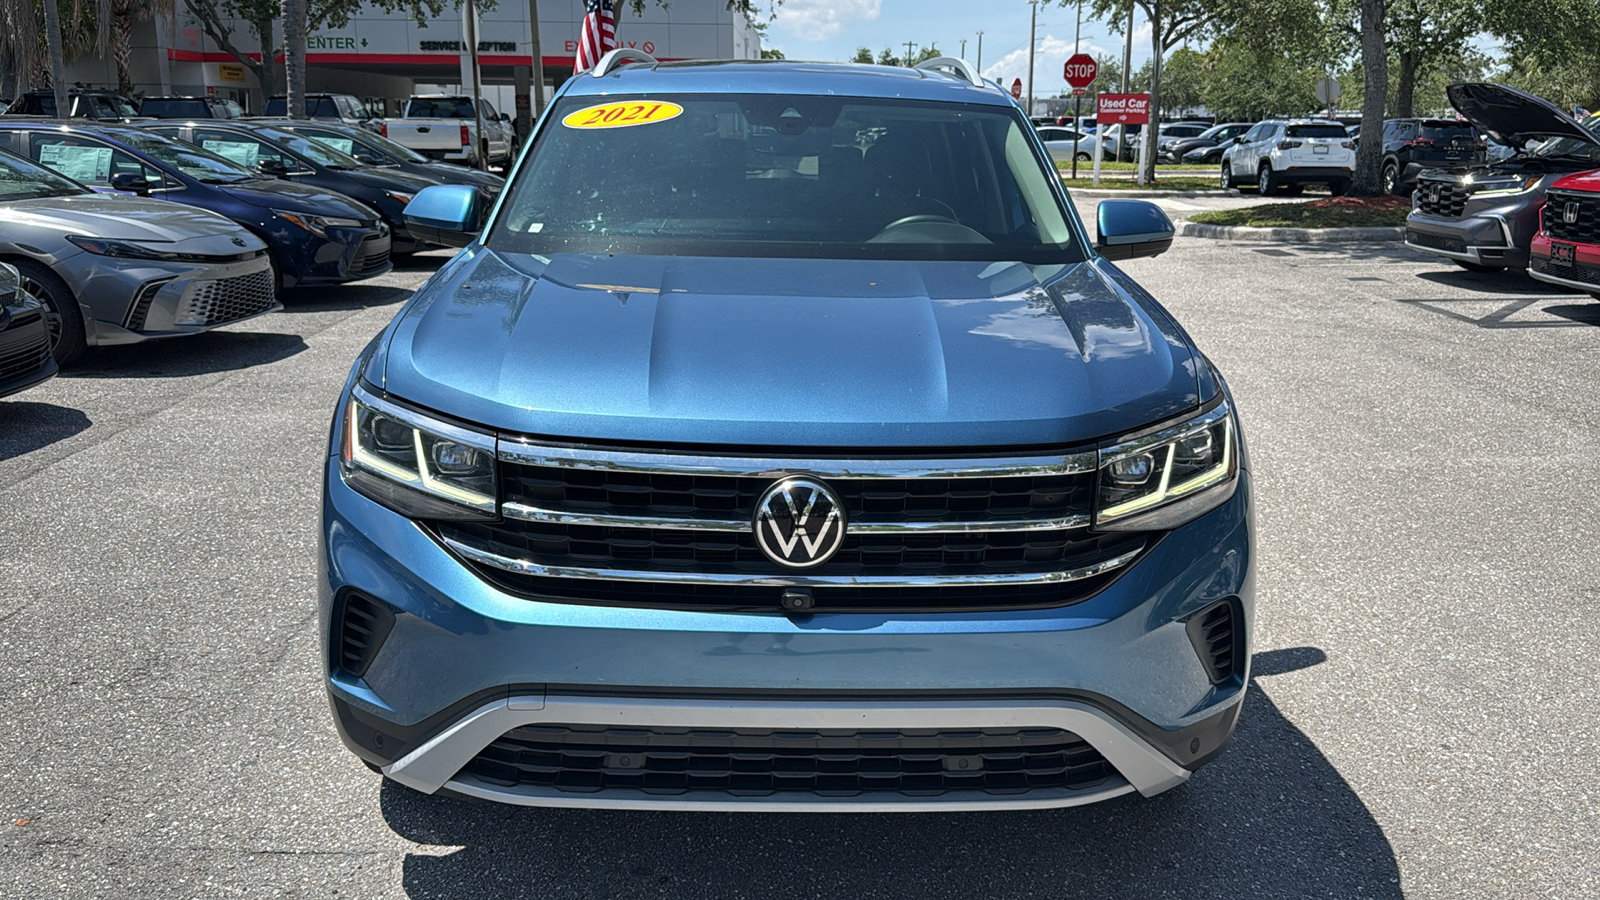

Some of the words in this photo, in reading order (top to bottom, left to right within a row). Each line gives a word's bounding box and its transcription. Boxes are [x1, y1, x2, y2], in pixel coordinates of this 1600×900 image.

[307, 37, 356, 49] ENTER
[420, 41, 460, 51] SERVICE
[1066, 64, 1095, 78] STOP
[1100, 98, 1126, 108] Used
[1128, 98, 1147, 108] Car
[581, 104, 663, 126] 2021
